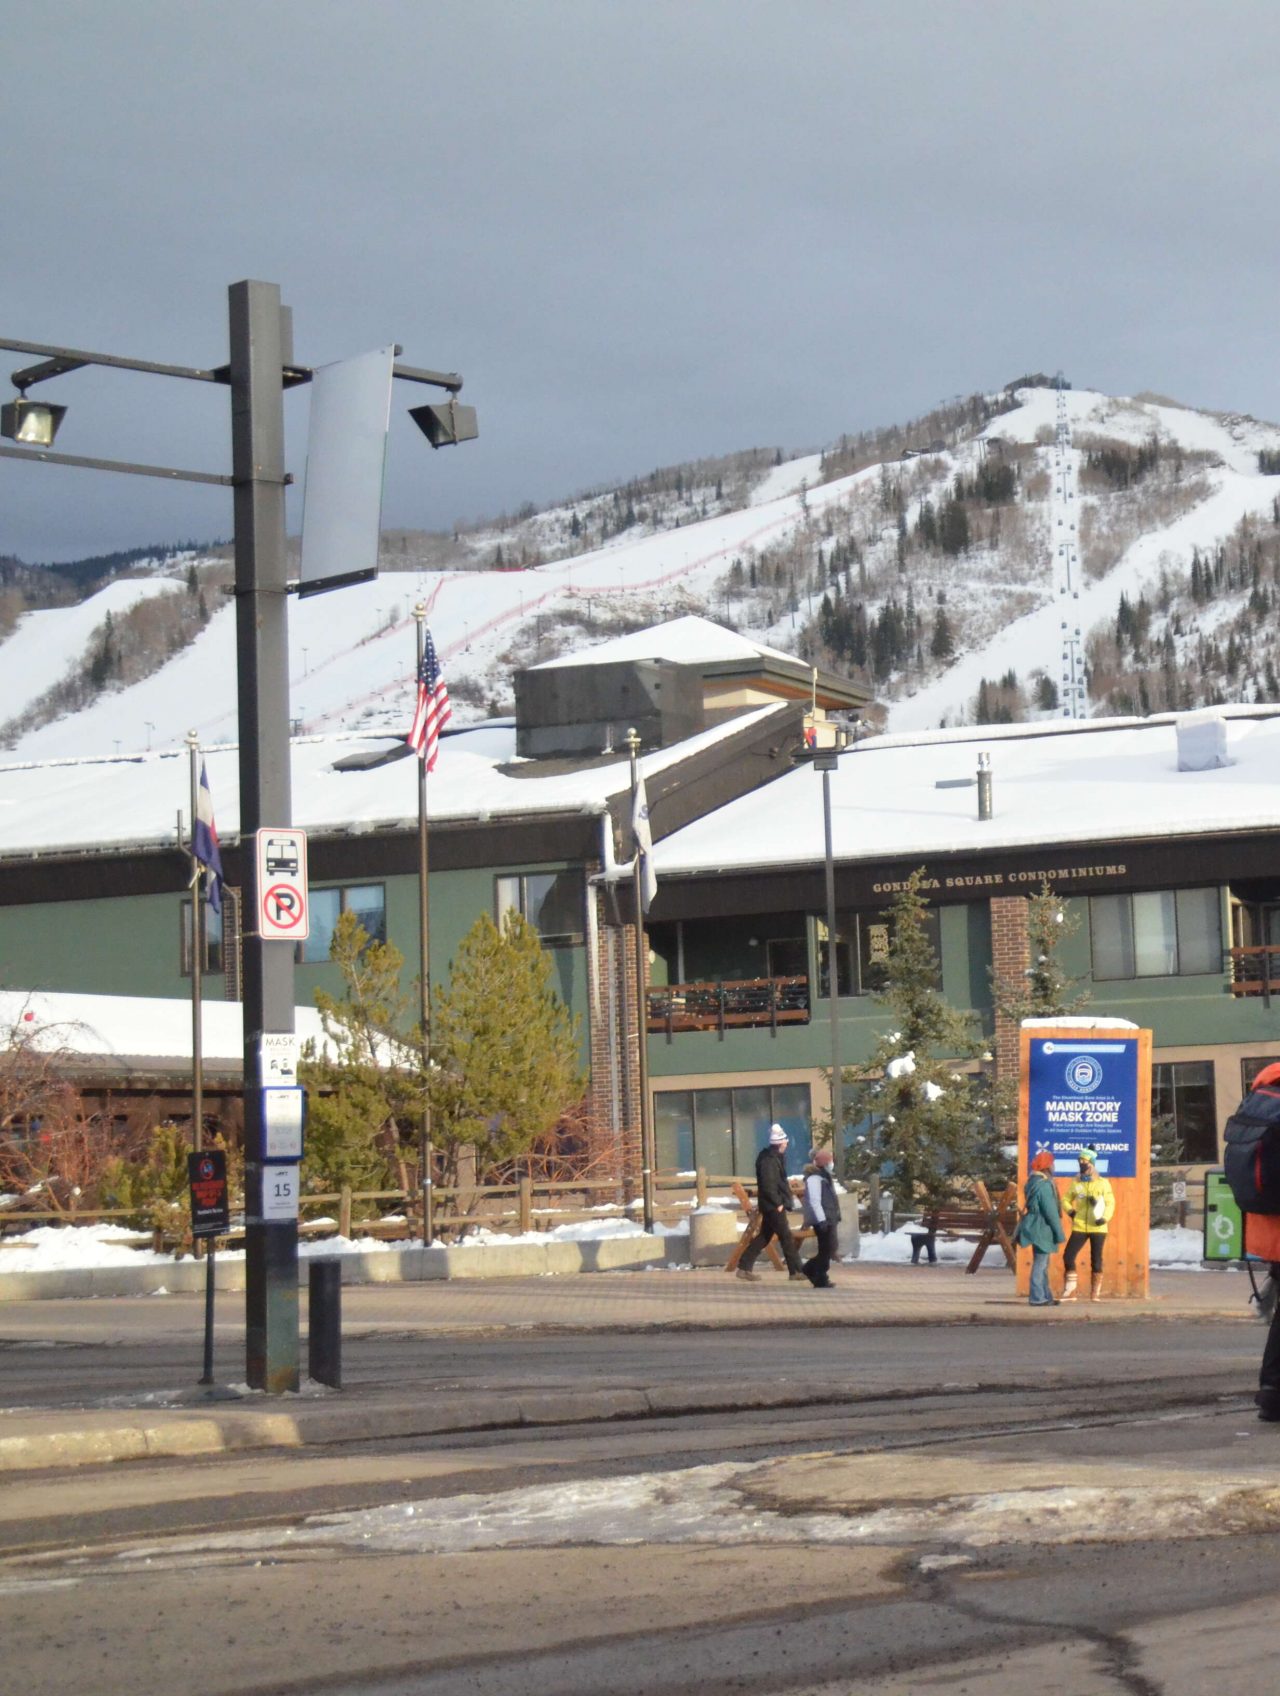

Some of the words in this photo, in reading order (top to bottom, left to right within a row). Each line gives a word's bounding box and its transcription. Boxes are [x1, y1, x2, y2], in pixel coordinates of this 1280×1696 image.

[946, 873, 1003, 888] SQUARE
[1009, 864, 1127, 882] CONDOMINIUMS
[266, 1035, 296, 1047] MASK
[1045, 1101, 1121, 1111] MANDATORY
[1048, 1111, 1083, 1122] MASK
[1085, 1112, 1119, 1122] ZONE
[1053, 1143, 1084, 1151] SOCIAL
[1087, 1143, 1129, 1151] STANCE
[274, 1183, 291, 1197] 15
